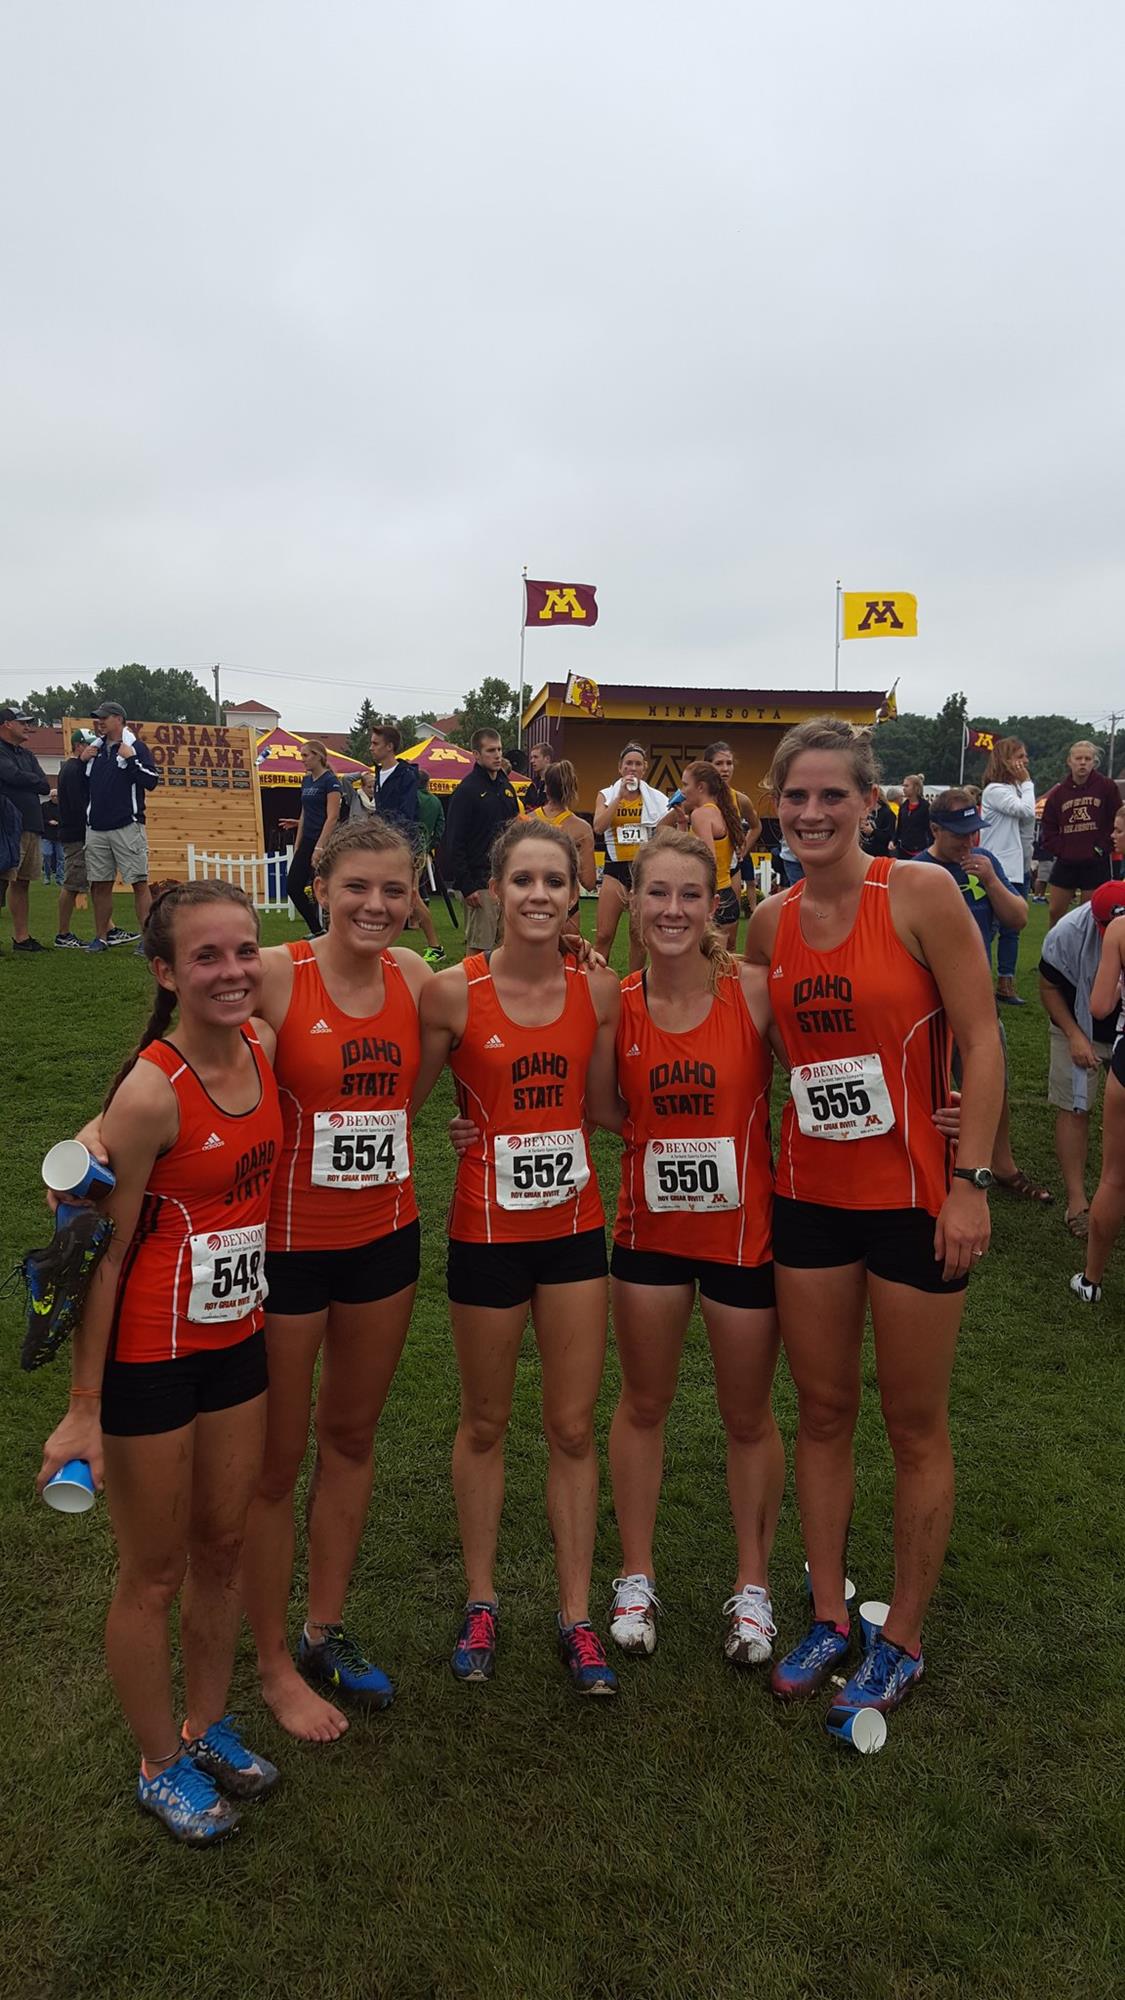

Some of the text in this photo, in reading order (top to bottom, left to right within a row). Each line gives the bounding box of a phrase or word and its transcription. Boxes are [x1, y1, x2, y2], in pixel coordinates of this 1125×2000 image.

[539, 587, 587, 620] M
[857, 600, 904, 632] M
[648, 705, 781, 720] MINNESOTA
[155, 725, 231, 748] GRIAK
[152, 745, 245, 769] OF FAME
[259, 774, 286, 785] NESOTA
[429, 782, 451, 792] ESOTA
[622, 829, 641, 840] 571
[793, 974, 852, 1007] IDAHO
[797, 1008, 857, 1033] STATE
[340, 1037, 403, 1070] IDAHO
[511, 1051, 569, 1085] IDAHO
[650, 1059, 717, 1092] IDAHO
[813, 1060, 864, 1079] BEYNON
[340, 1072, 400, 1097] STATE
[513, 1084, 565, 1111] STATE
[653, 1094, 715, 1116] STATE
[807, 1079, 871, 1122] 555
[346, 1114, 397, 1127] BEYNON
[332, 1134, 395, 1172] 554
[523, 1134, 575, 1148] BEYNON
[666, 1141, 717, 1153] BEYNON
[233, 1139, 276, 1185] IDAHO
[513, 1152, 574, 1190] 552
[327, 1174, 340, 1182] ROY
[657, 1159, 719, 1193] 550
[511, 1191, 523, 1199] ROY
[222, 1228, 265, 1248] BEYNON
[204, 1301, 218, 1311] ROY
